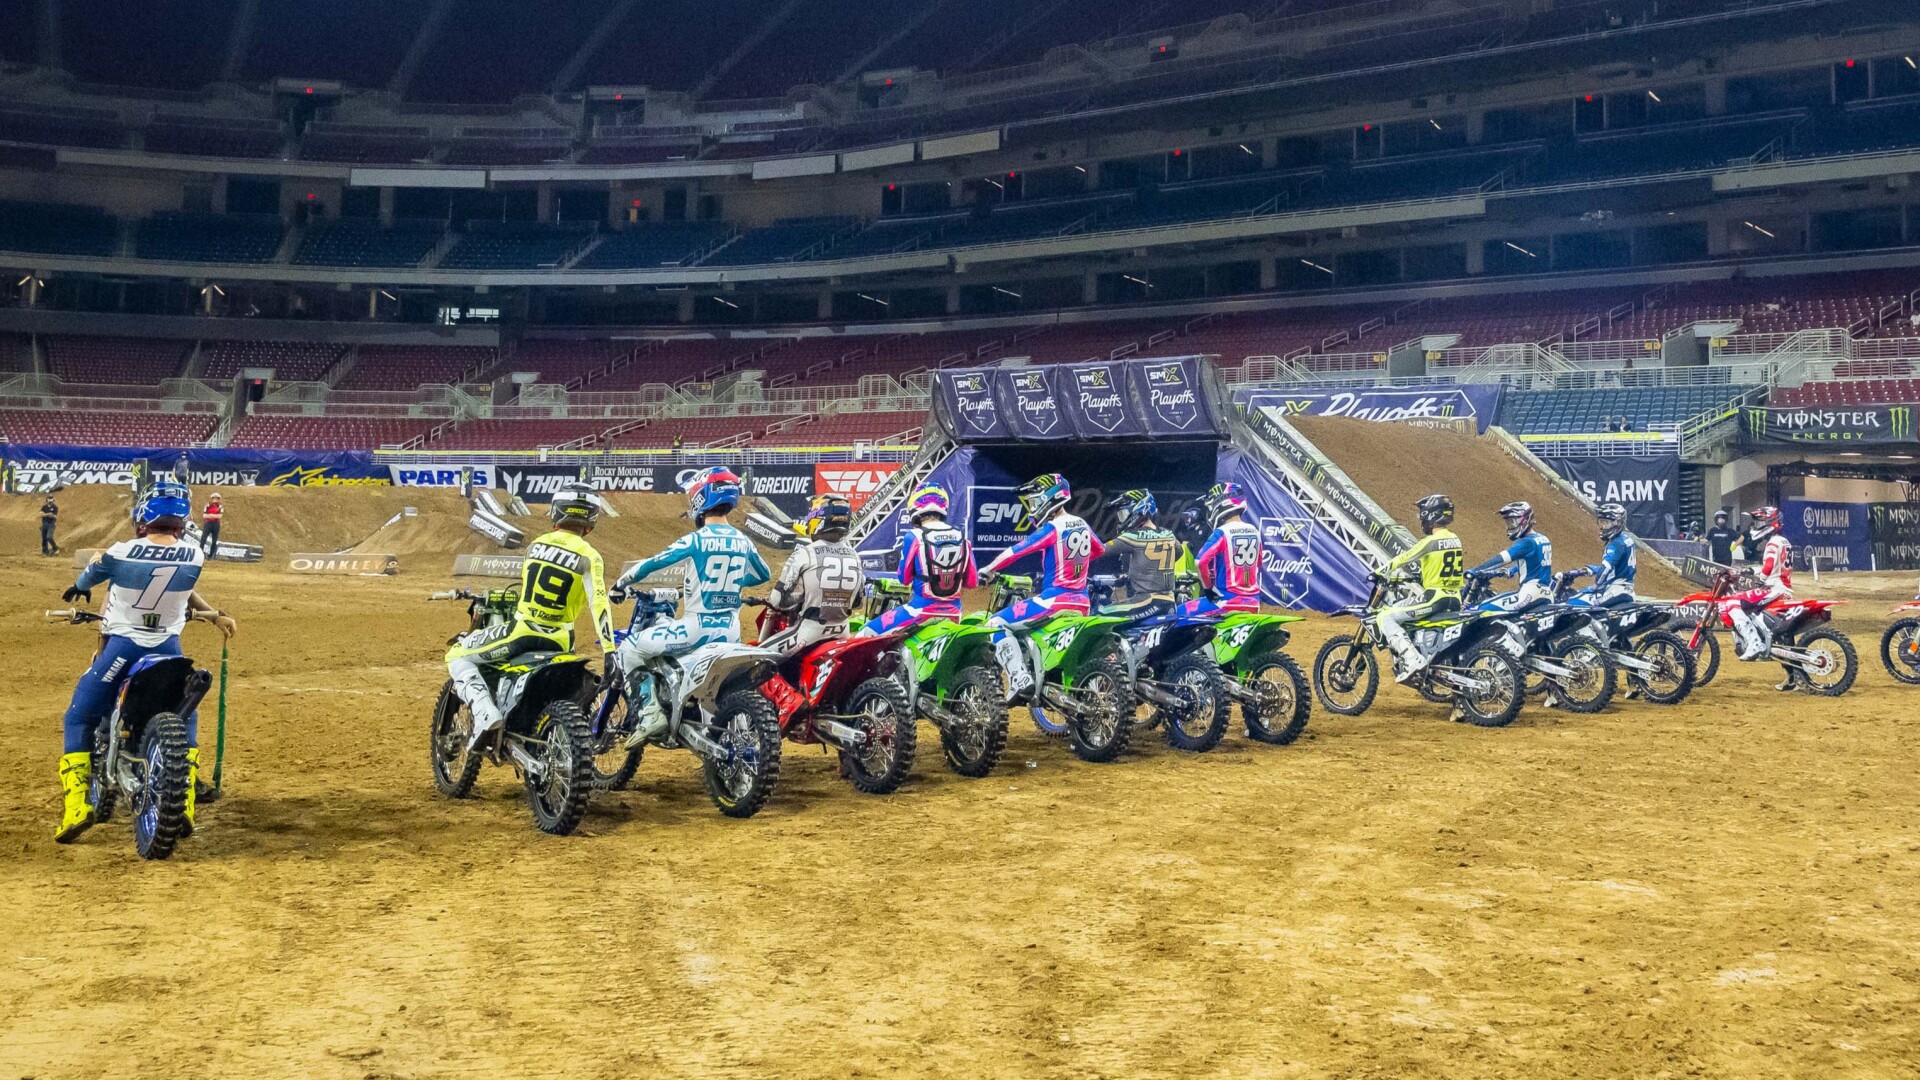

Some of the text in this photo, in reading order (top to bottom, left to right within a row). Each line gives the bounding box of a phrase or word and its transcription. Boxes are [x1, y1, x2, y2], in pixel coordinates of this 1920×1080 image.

[957, 377, 983, 390] SMX
[1016, 375, 1042, 389] SMX
[1080, 371, 1107, 385] SMX
[1150, 367, 1180, 382] SMX
[958, 397, 994, 414] Playoffs
[1018, 396, 1056, 415] Playoffs
[1080, 392, 1122, 412] Playoffs
[1151, 389, 1195, 410] Playoffs
[1776, 410, 1880, 429] MONSTER
[1263, 421, 1303, 461] MONSTER
[1792, 432, 1864, 441] ENERGY
[24, 460, 69, 470] ROCKY
[595, 466, 653, 476] ROCKY MOUNTAIN
[152, 470, 237, 485] TRUMPH
[1605, 479, 1669, 502] ARMY
[1325, 482, 1368, 526] MONSTER
[1814, 509, 1850, 528] YAMAHA
[745, 518, 781, 544] PROGRESSIVE
[977, 534, 1001, 542] WORLD
[1263, 523, 1305, 542] SMX
[126, 544, 196, 563] DEEGAN
[1067, 529, 1091, 560] 98
[1233, 538, 1258, 566] 36
[315, 558, 380, 571] OAKLEY
[483, 557, 522, 570] MONSTE
[529, 543, 581, 571] SMITH
[935, 546, 961, 567] 47
[1262, 549, 1313, 580] Playoffs
[1439, 550, 1463, 577] 83
[701, 554, 747, 592] 92
[820, 556, 858, 590] 25
[132, 564, 180, 611] 1
[523, 561, 575, 610] 19
[1502, 595, 1519, 606] FLY
[1131, 606, 1159, 621] YAMAHA
[1619, 612, 1637, 627] 44
[822, 625, 846, 635] FLY
[1537, 615, 1555, 632] 302
[778, 634, 799, 654] FLY
[1145, 626, 1164, 649] 41
[1230, 625, 1250, 648] 36
[101, 656, 127, 683] YAMAHA
